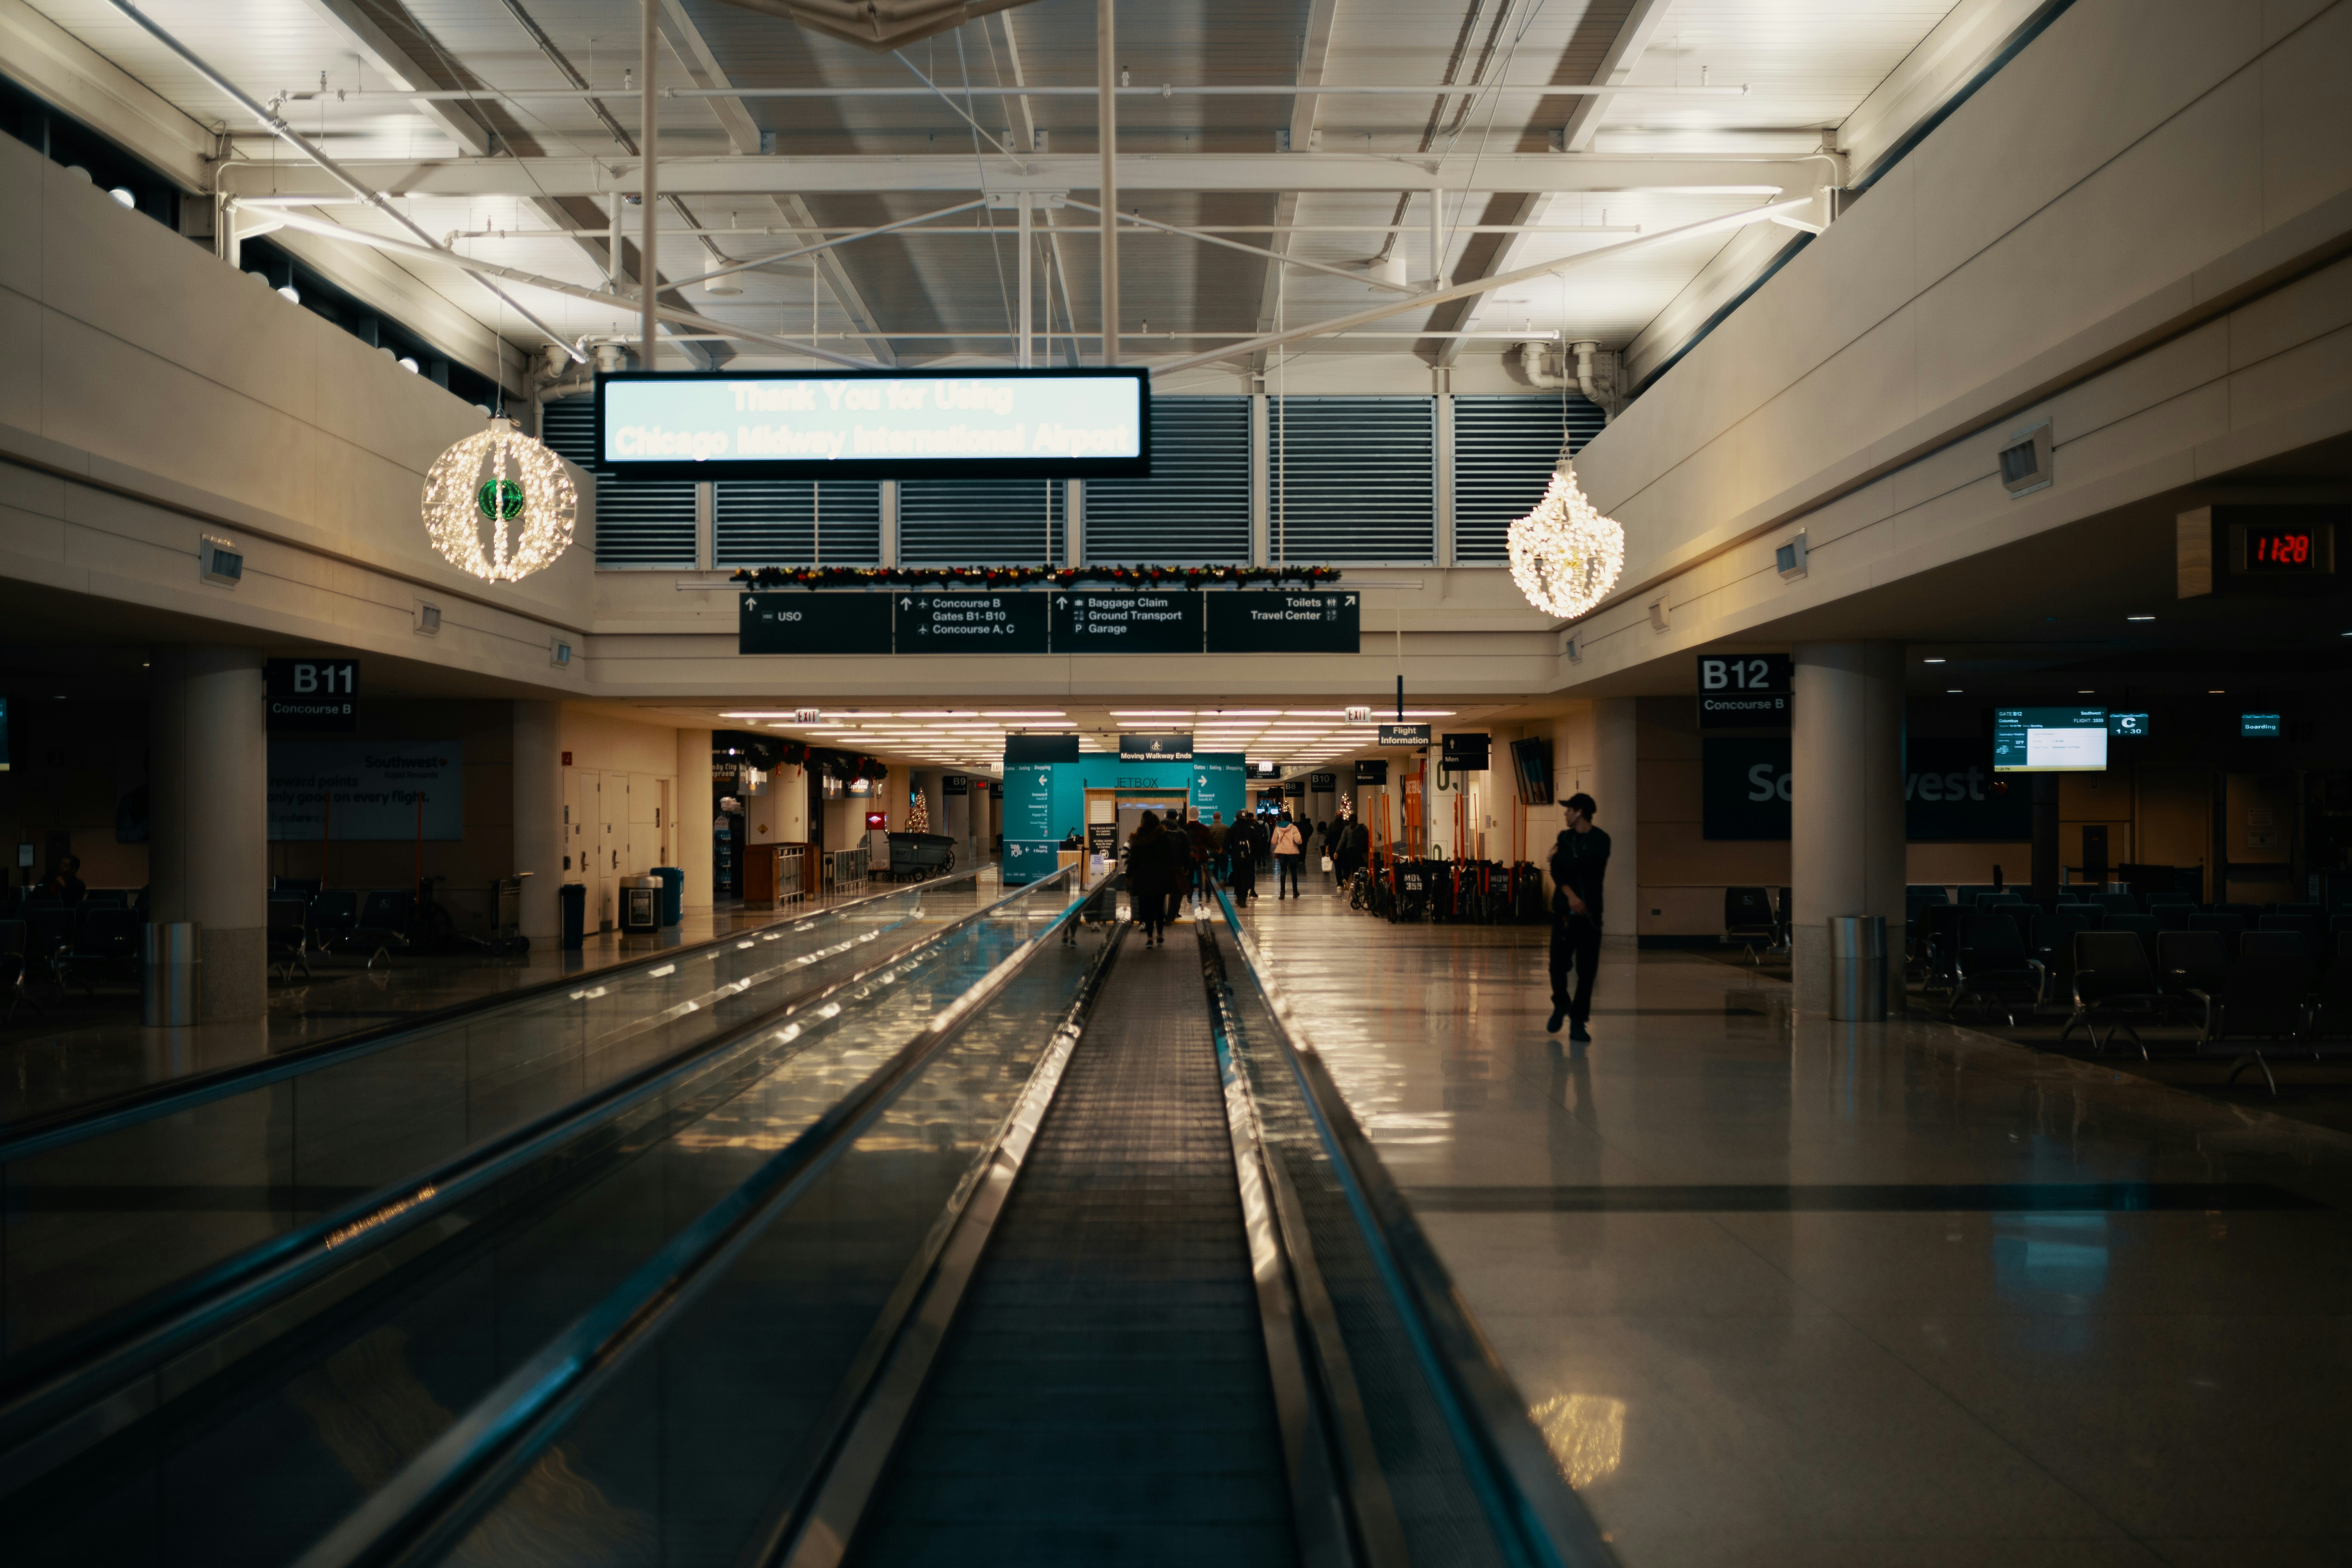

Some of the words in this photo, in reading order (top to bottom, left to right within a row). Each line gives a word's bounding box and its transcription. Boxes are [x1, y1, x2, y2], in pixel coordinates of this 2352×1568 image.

[728, 382, 815, 412] Thank
[822, 382, 881, 411] You
[887, 381, 928, 411] for
[934, 380, 1014, 416] Using
[615, 425, 728, 460] Chicago
[737, 424, 846, 459] Midway
[854, 423, 1024, 454] International
[1032, 423, 1130, 457] Airport
[2258, 535, 2309, 563] 11:28
[932, 598, 990, 608] Concourse
[993, 598, 1001, 608] B
[1088, 598, 1135, 609] Baggage
[1138, 598, 1168, 607] Claim
[1286, 597, 1321, 607] Toilets
[778, 612, 802, 621] USO
[933, 611, 964, 621] Gates
[966, 611, 1006, 621] B1-B10
[1088, 611, 1128, 620] Ground
[1130, 611, 1182, 622] Transport
[1251, 610, 1283, 620] Travel
[1285, 610, 1321, 620] Center
[933, 624, 990, 634] Concourse
[992, 624, 1003, 634] A,
[1006, 624, 1014, 634] C
[1088, 624, 1127, 635] Garage
[294, 665, 352, 693] B11
[1703, 660, 1769, 689] B12
[273, 703, 339, 714] Concourse
[343, 704, 351, 714] B
[1704, 700, 1771, 710] Concourse
[1775, 698, 1784, 708] B
[798, 711, 816, 722] EXIT
[1348, 709, 1366, 720] EXIT
[2121, 717, 2136, 728] C
[1393, 727, 1416, 735] Flight
[365, 756, 438, 768] Southwest
[725, 763, 736, 772] City
[384, 771, 404, 780] Rapid
[953, 777, 966, 785] B9
[1312, 775, 1329, 783] B10
[270, 776, 315, 787] reward
[318, 775, 359, 790] points
[1114, 778, 1159, 788] JETBOX
[267, 791, 294, 805] only
[334, 793, 350, 802] on
[353, 793, 389, 805] every
